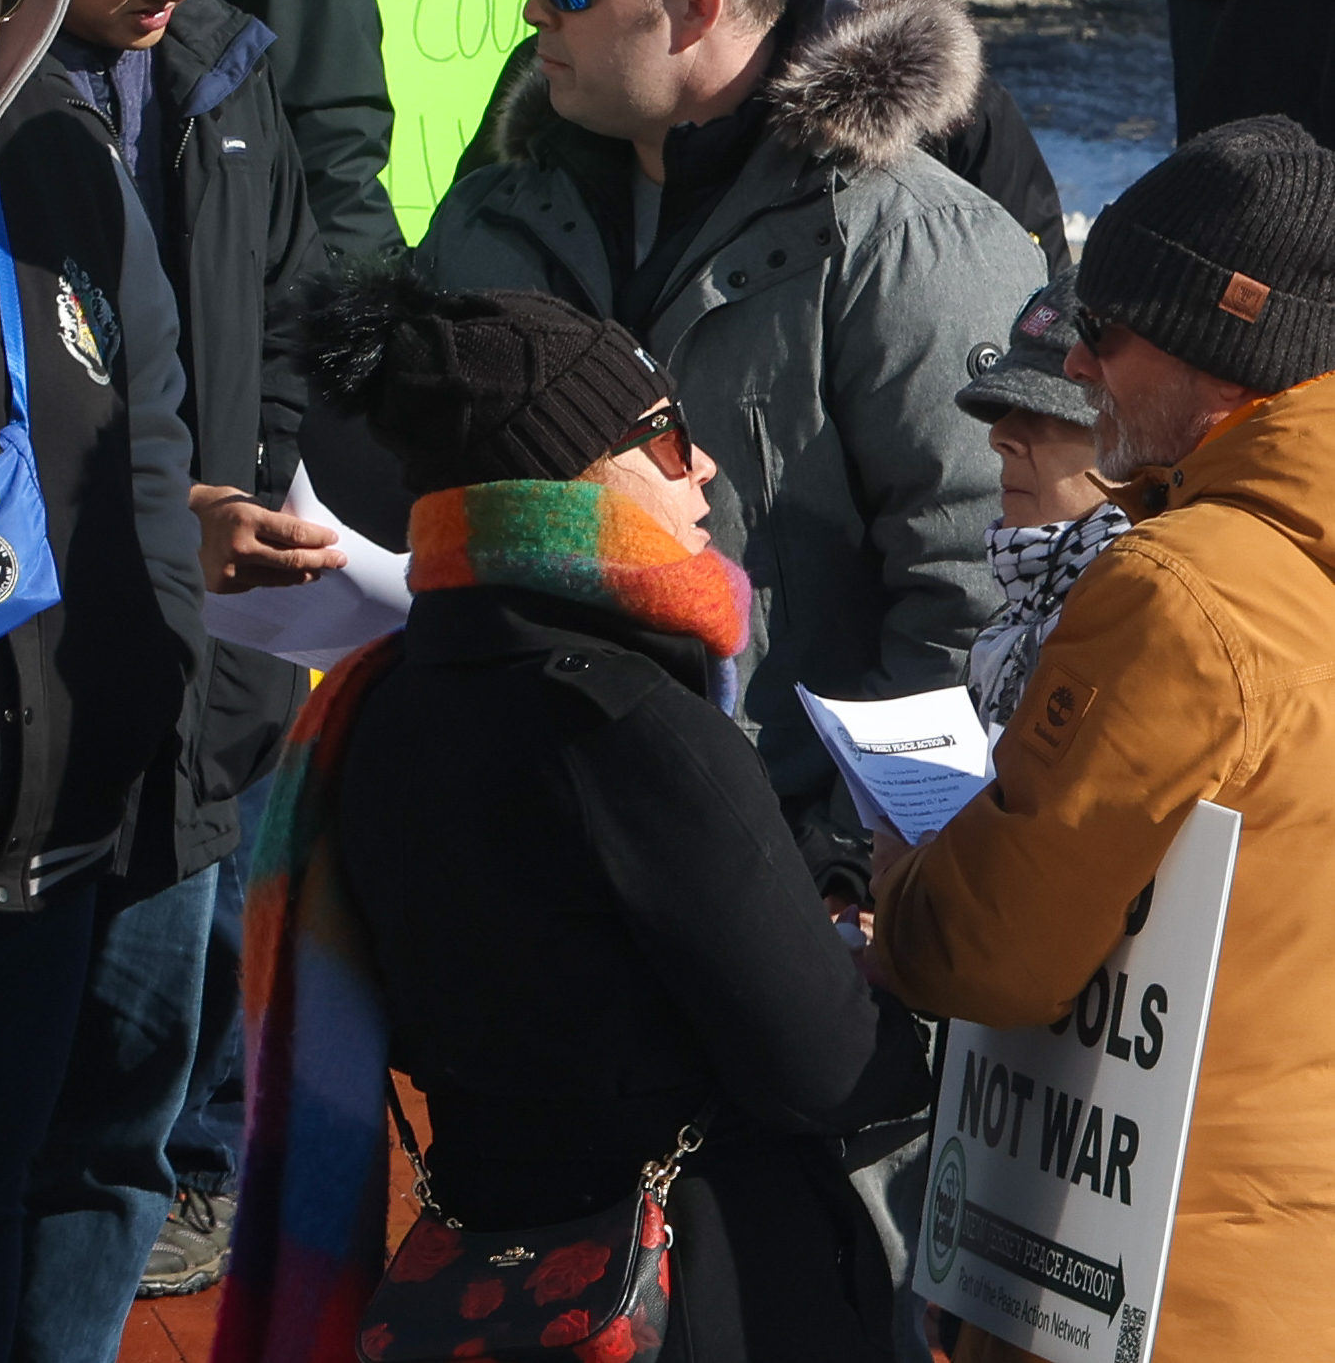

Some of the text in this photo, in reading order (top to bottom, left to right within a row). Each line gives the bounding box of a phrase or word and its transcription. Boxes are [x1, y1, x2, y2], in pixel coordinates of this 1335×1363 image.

[1049, 965, 1168, 1071] OLS
[957, 1050, 1139, 1206] NOT WAR
[959, 1266, 1092, 1350] Part of the Peace Action Network
[1022, 1235, 1063, 1280] PEACE
[1062, 1257, 1115, 1302] ACTION
